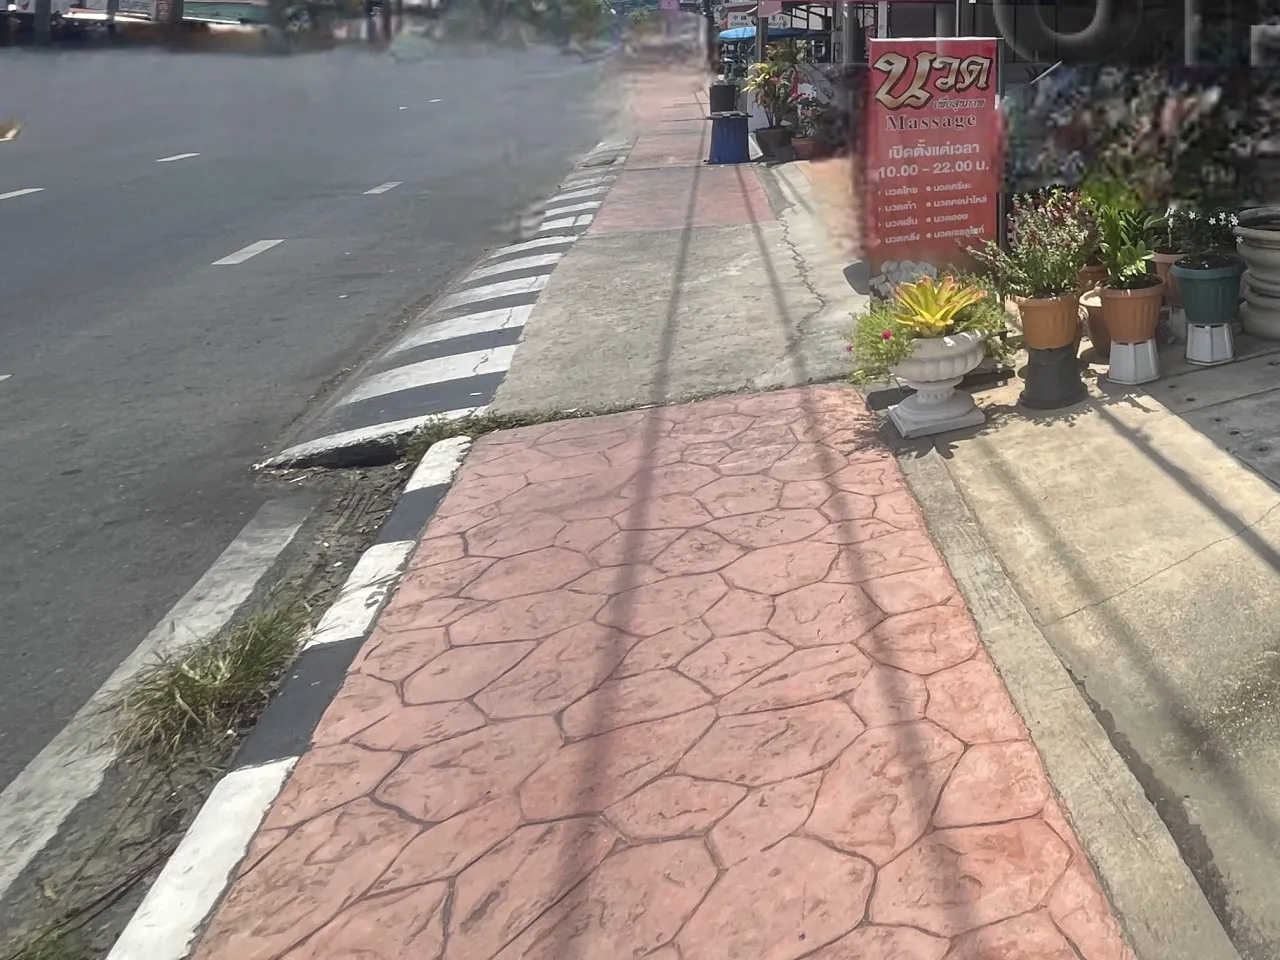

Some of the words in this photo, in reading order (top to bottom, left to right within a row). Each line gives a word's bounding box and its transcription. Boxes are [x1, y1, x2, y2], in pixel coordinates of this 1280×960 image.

[873, 50, 993, 111] นวด
[885, 114, 977, 132] Massage
[888, 139, 980, 160] เปิดตั้งแต่เวลา
[877, 163, 919, 180] 10.00
[932, 160, 973, 176] 22.00
